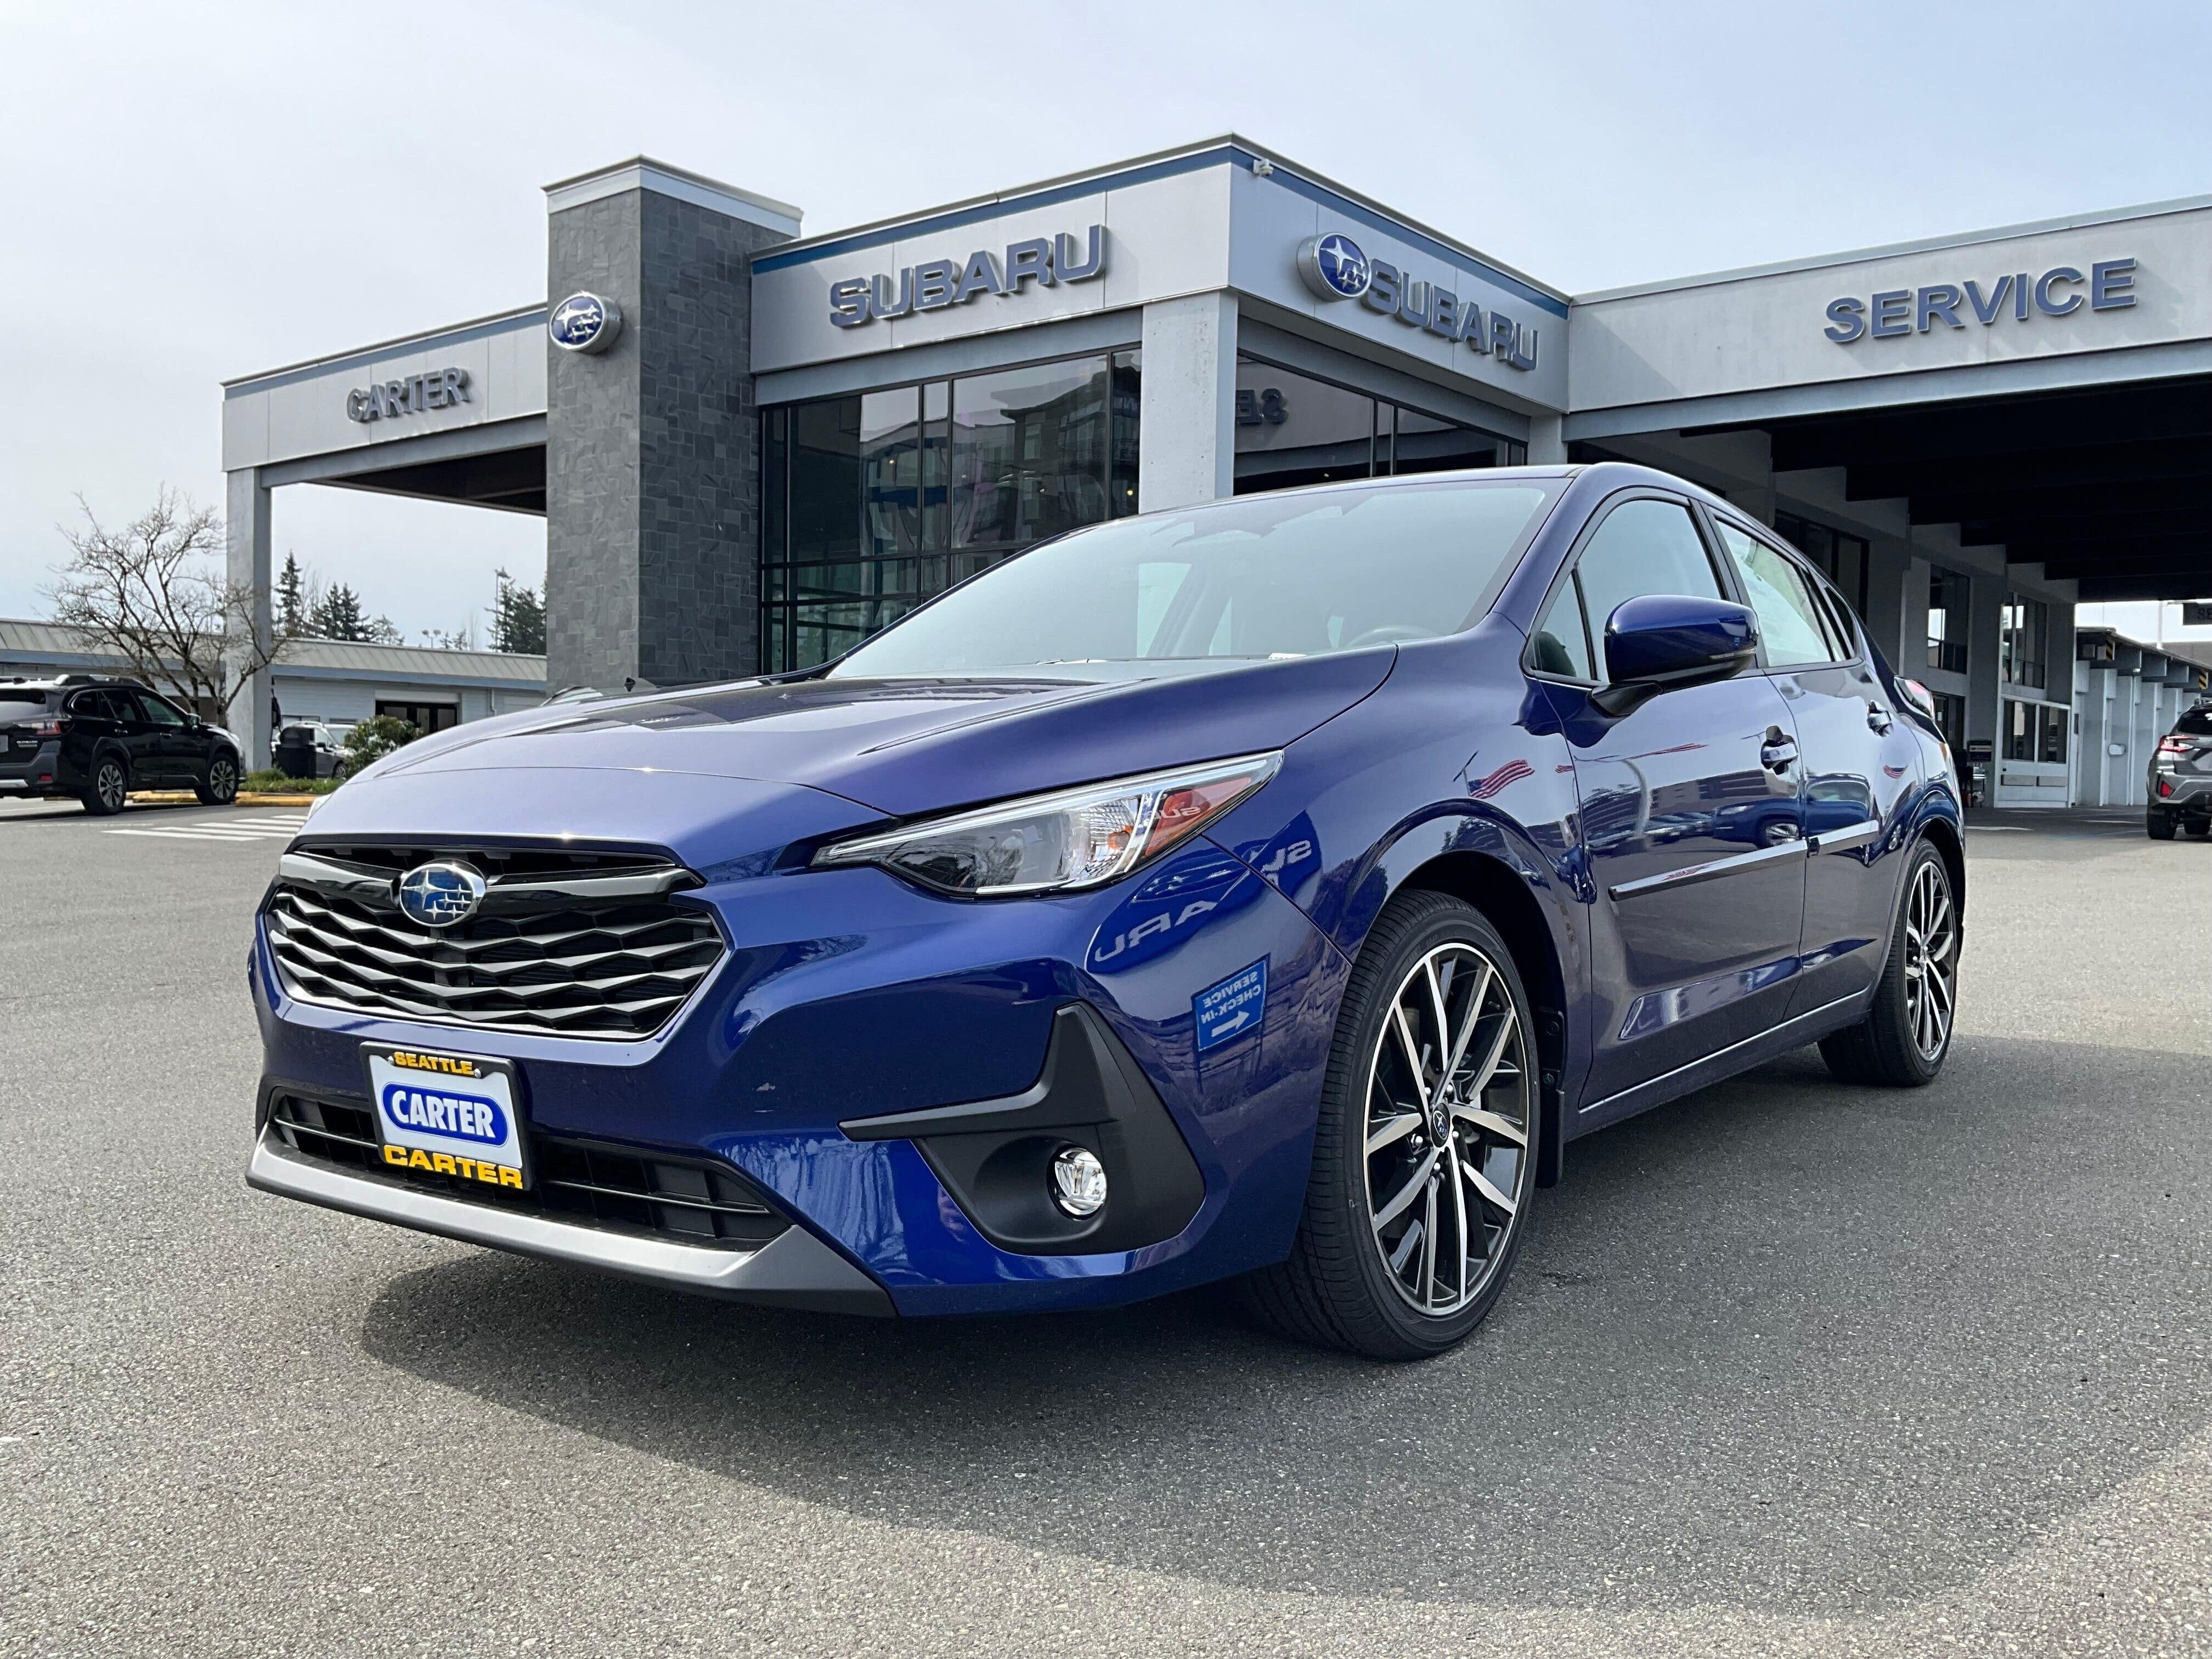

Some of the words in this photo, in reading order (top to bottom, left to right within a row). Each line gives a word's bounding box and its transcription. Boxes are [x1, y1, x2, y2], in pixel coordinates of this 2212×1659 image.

[830, 224, 1107, 328] SUBARU
[1823, 257, 2137, 343] SERVICE
[1361, 259, 1539, 371] SUBARU
[346, 367, 470, 423] CARTER
[393, 1051, 475, 1077] SEATTLE
[391, 1090, 496, 1138] CARTER
[383, 1144, 523, 1189] CARTER
